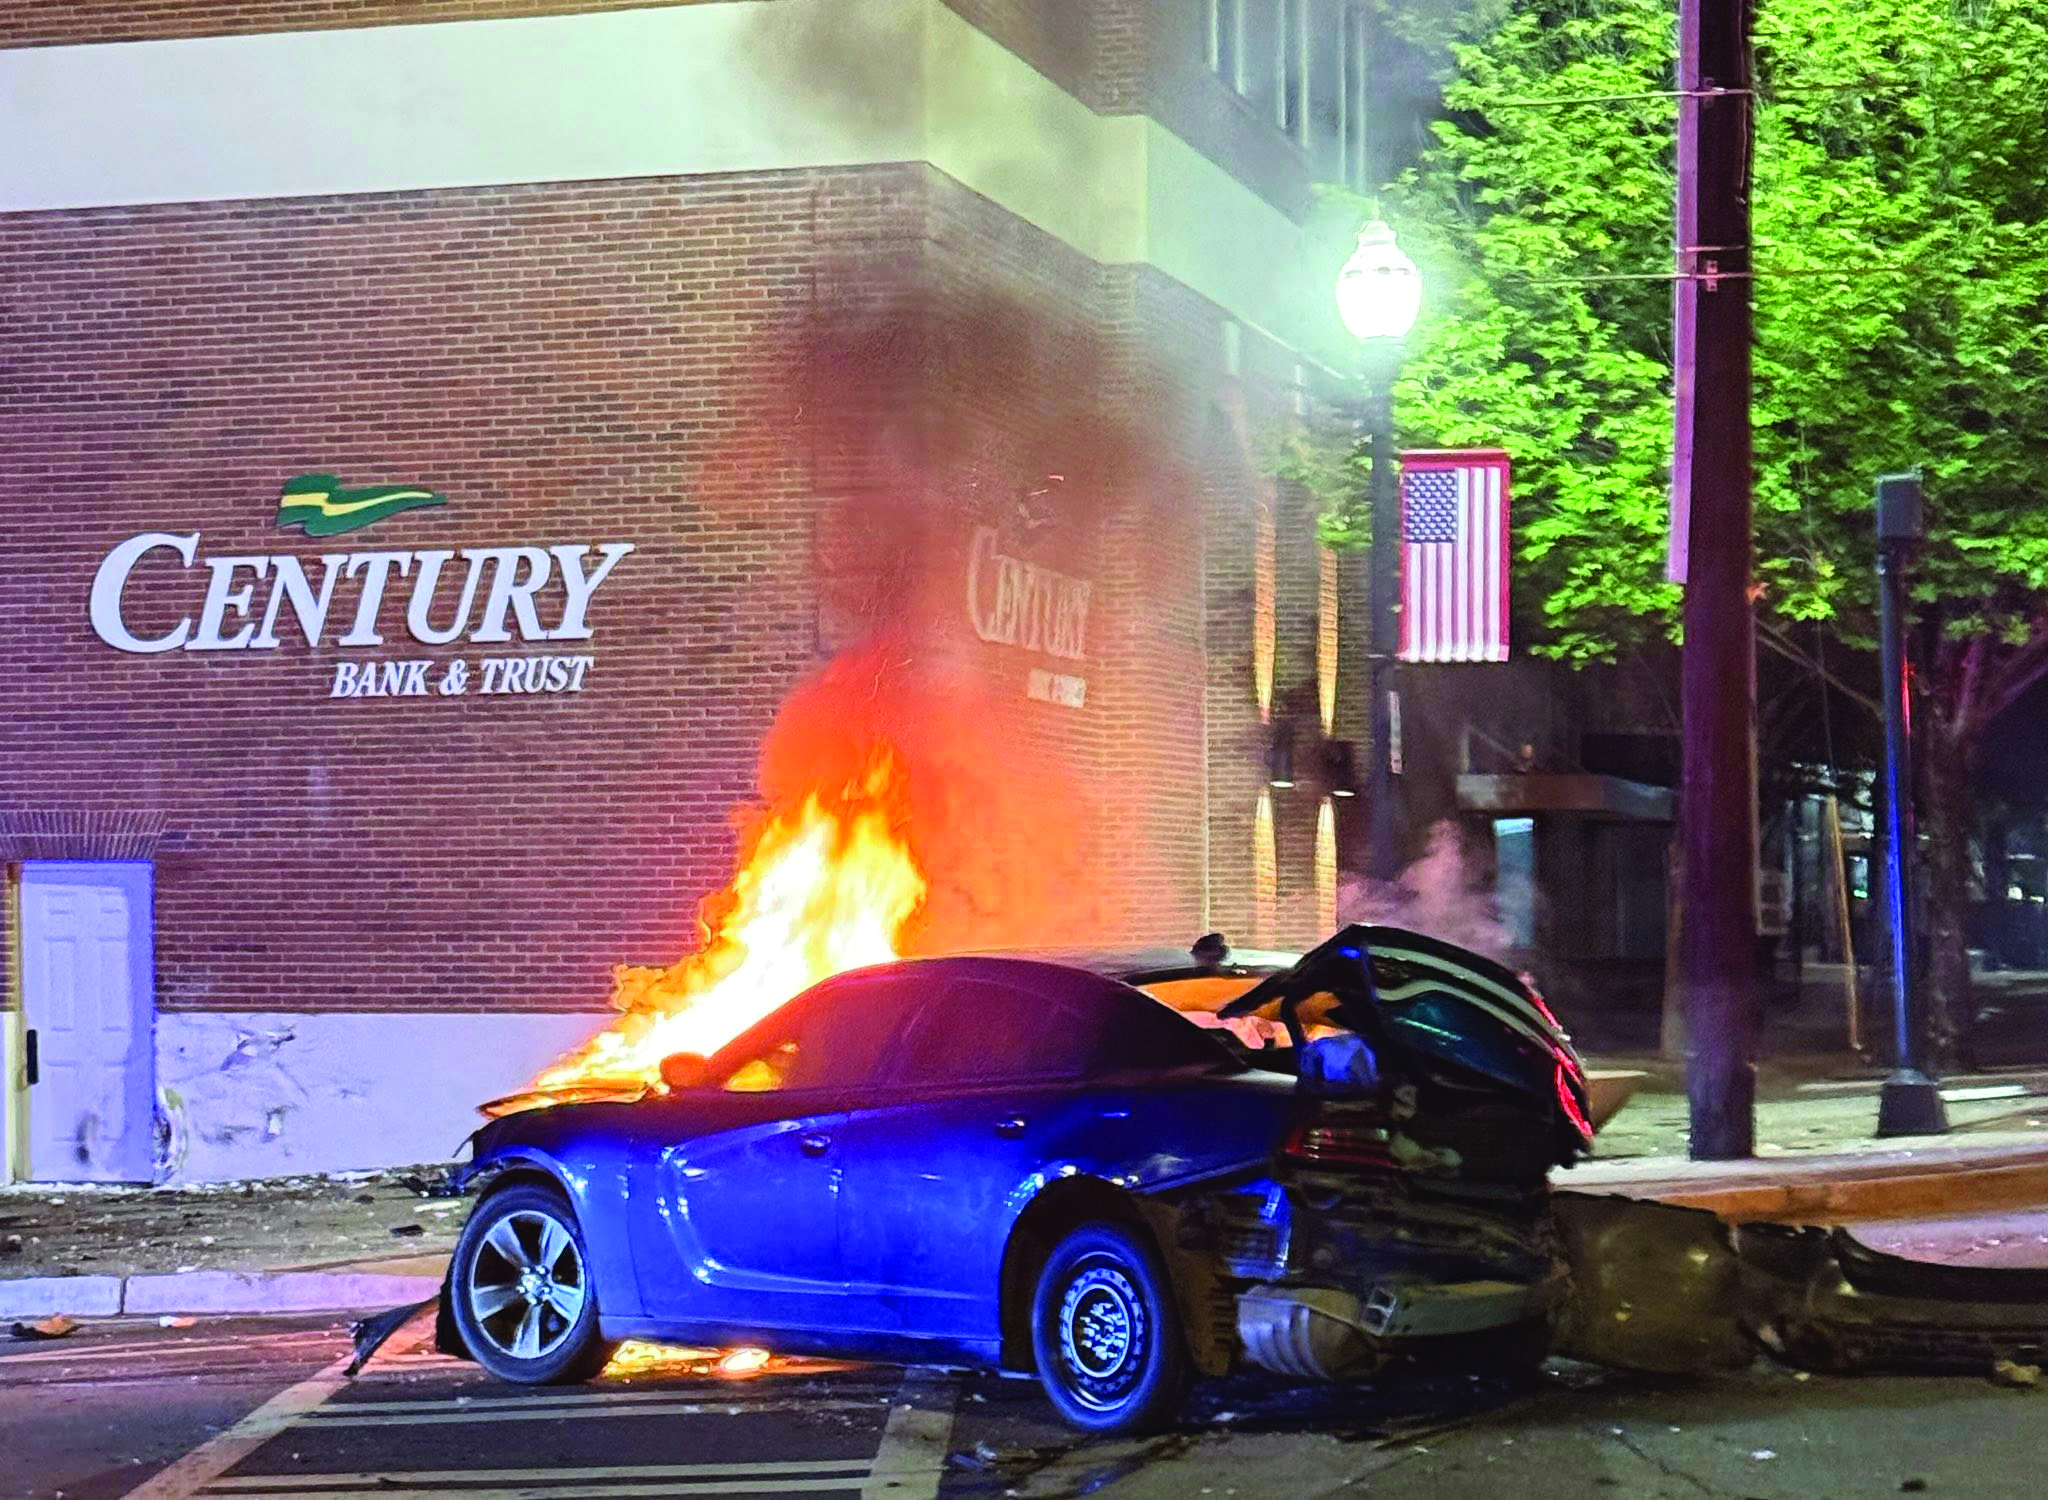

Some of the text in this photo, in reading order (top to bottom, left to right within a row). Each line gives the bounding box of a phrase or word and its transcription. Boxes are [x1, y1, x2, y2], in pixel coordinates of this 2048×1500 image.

[90, 532, 635, 653] CENTURY
[330, 656, 594, 698] BANK & TRUST
